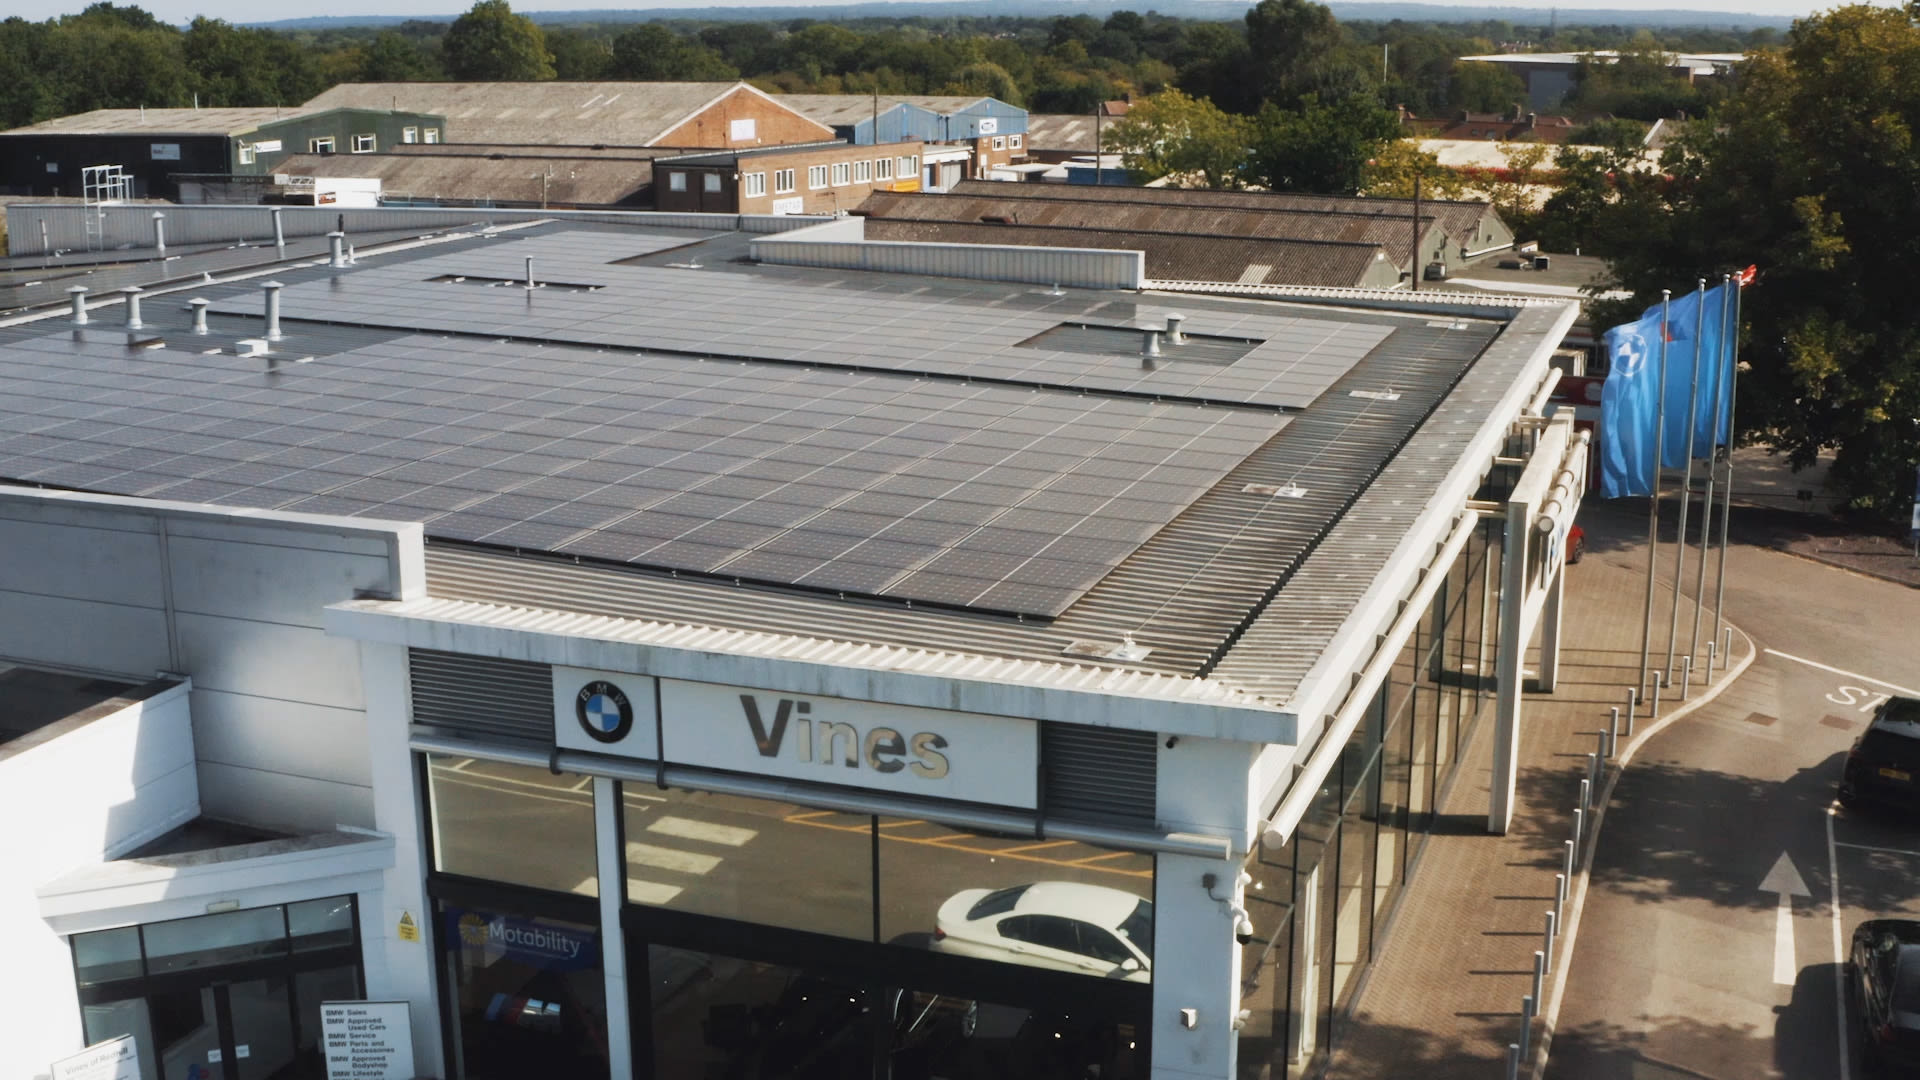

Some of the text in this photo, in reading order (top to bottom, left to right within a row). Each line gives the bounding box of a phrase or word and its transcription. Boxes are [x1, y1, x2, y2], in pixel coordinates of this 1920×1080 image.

[1825, 686, 1892, 713] ST
[739, 694, 950, 780] Vines
[489, 921, 581, 958] Motability
[352, 1055, 386, 1063] Approved
